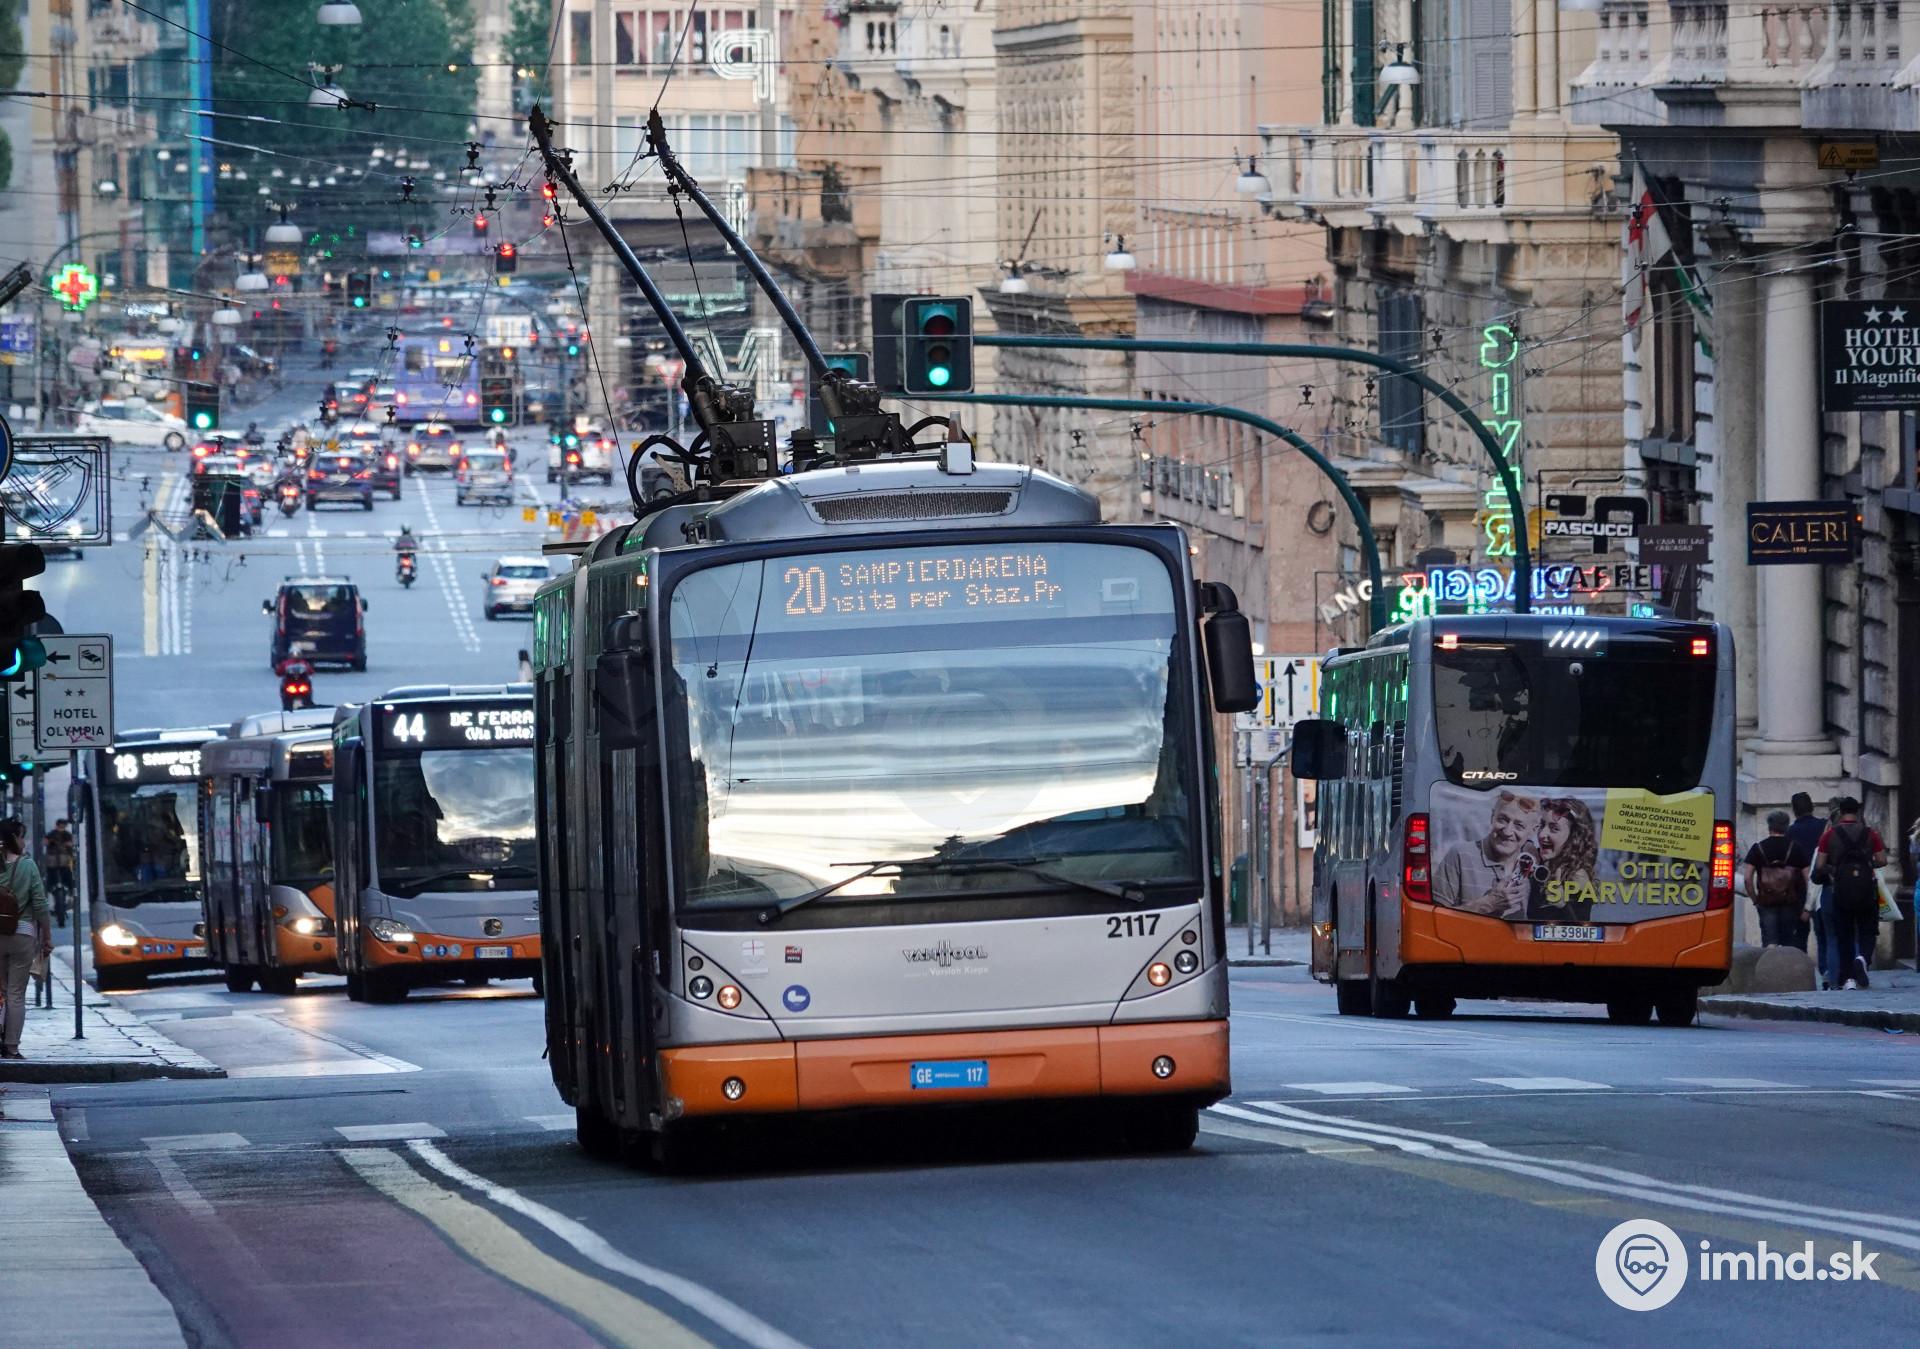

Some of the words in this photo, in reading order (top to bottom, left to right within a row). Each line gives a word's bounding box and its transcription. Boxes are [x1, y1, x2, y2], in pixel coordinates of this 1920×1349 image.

[1834, 369, 1848, 384] Il
[1545, 522, 1633, 536] PASCUCCI
[1752, 521, 1848, 543] CALERI
[784, 566, 827, 615] 20
[840, 554, 1047, 586] SAMPIERDARENA
[53, 708, 97, 719] HOTEL
[46, 726, 104, 736] OLYMPIA
[393, 713, 426, 742] 44
[450, 712, 473, 726] DE
[478, 710, 534, 725] FERRA
[1462, 771, 1518, 780] CITARO
[1619, 810, 1647, 819] ORARIO
[1649, 814, 1696, 826] CONTINUATO
[1620, 861, 1701, 880] OTTICA
[1546, 880, 1704, 906] SPARVIERO
[1106, 914, 1161, 939] 2117
[916, 1068, 932, 1083] GE
[967, 1067, 983, 1082] 117
